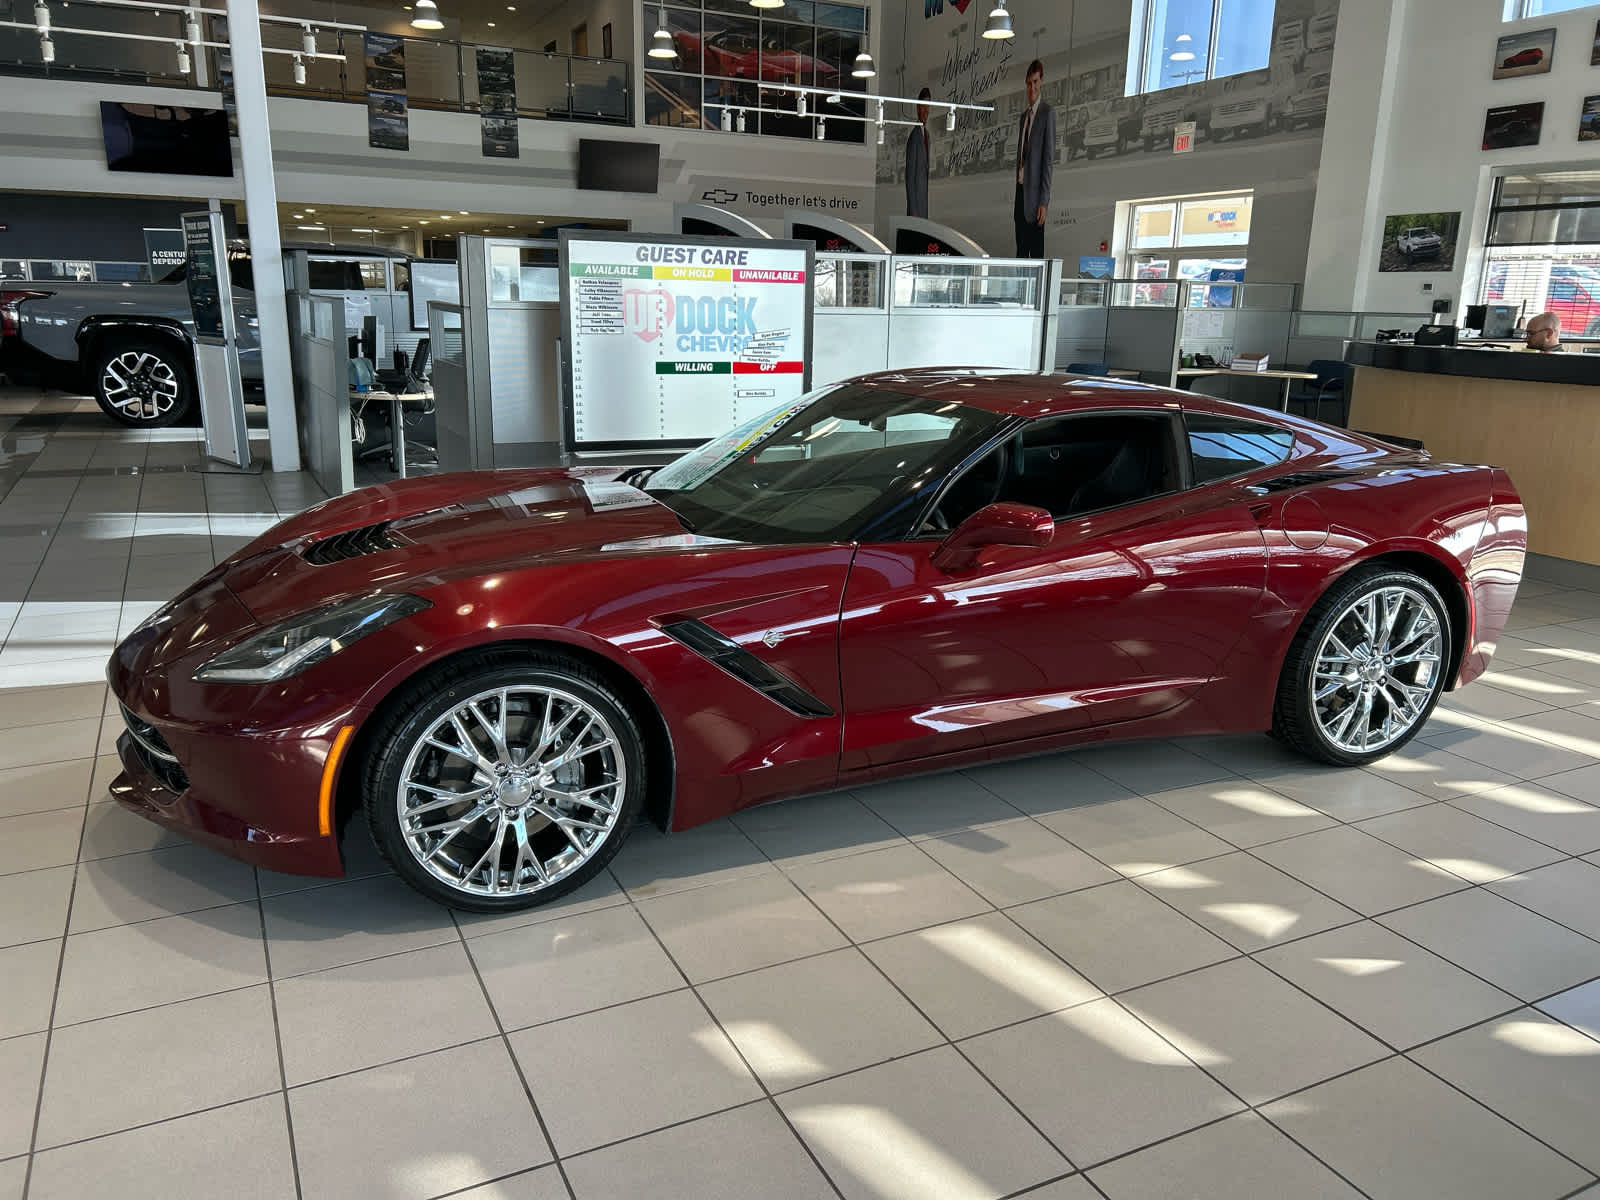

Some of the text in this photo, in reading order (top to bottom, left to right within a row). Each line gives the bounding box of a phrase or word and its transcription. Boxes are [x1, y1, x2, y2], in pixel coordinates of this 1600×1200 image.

[1176, 135, 1190, 151] EXIT
[745, 191, 858, 209] Together let's drive
[636, 246, 748, 266] GUEST CARE
[585, 265, 639, 276] AVAILABLE
[672, 268, 714, 278] ON HOLD
[740, 270, 799, 281] UNAVAILABLE
[675, 362, 714, 372] WILLING
